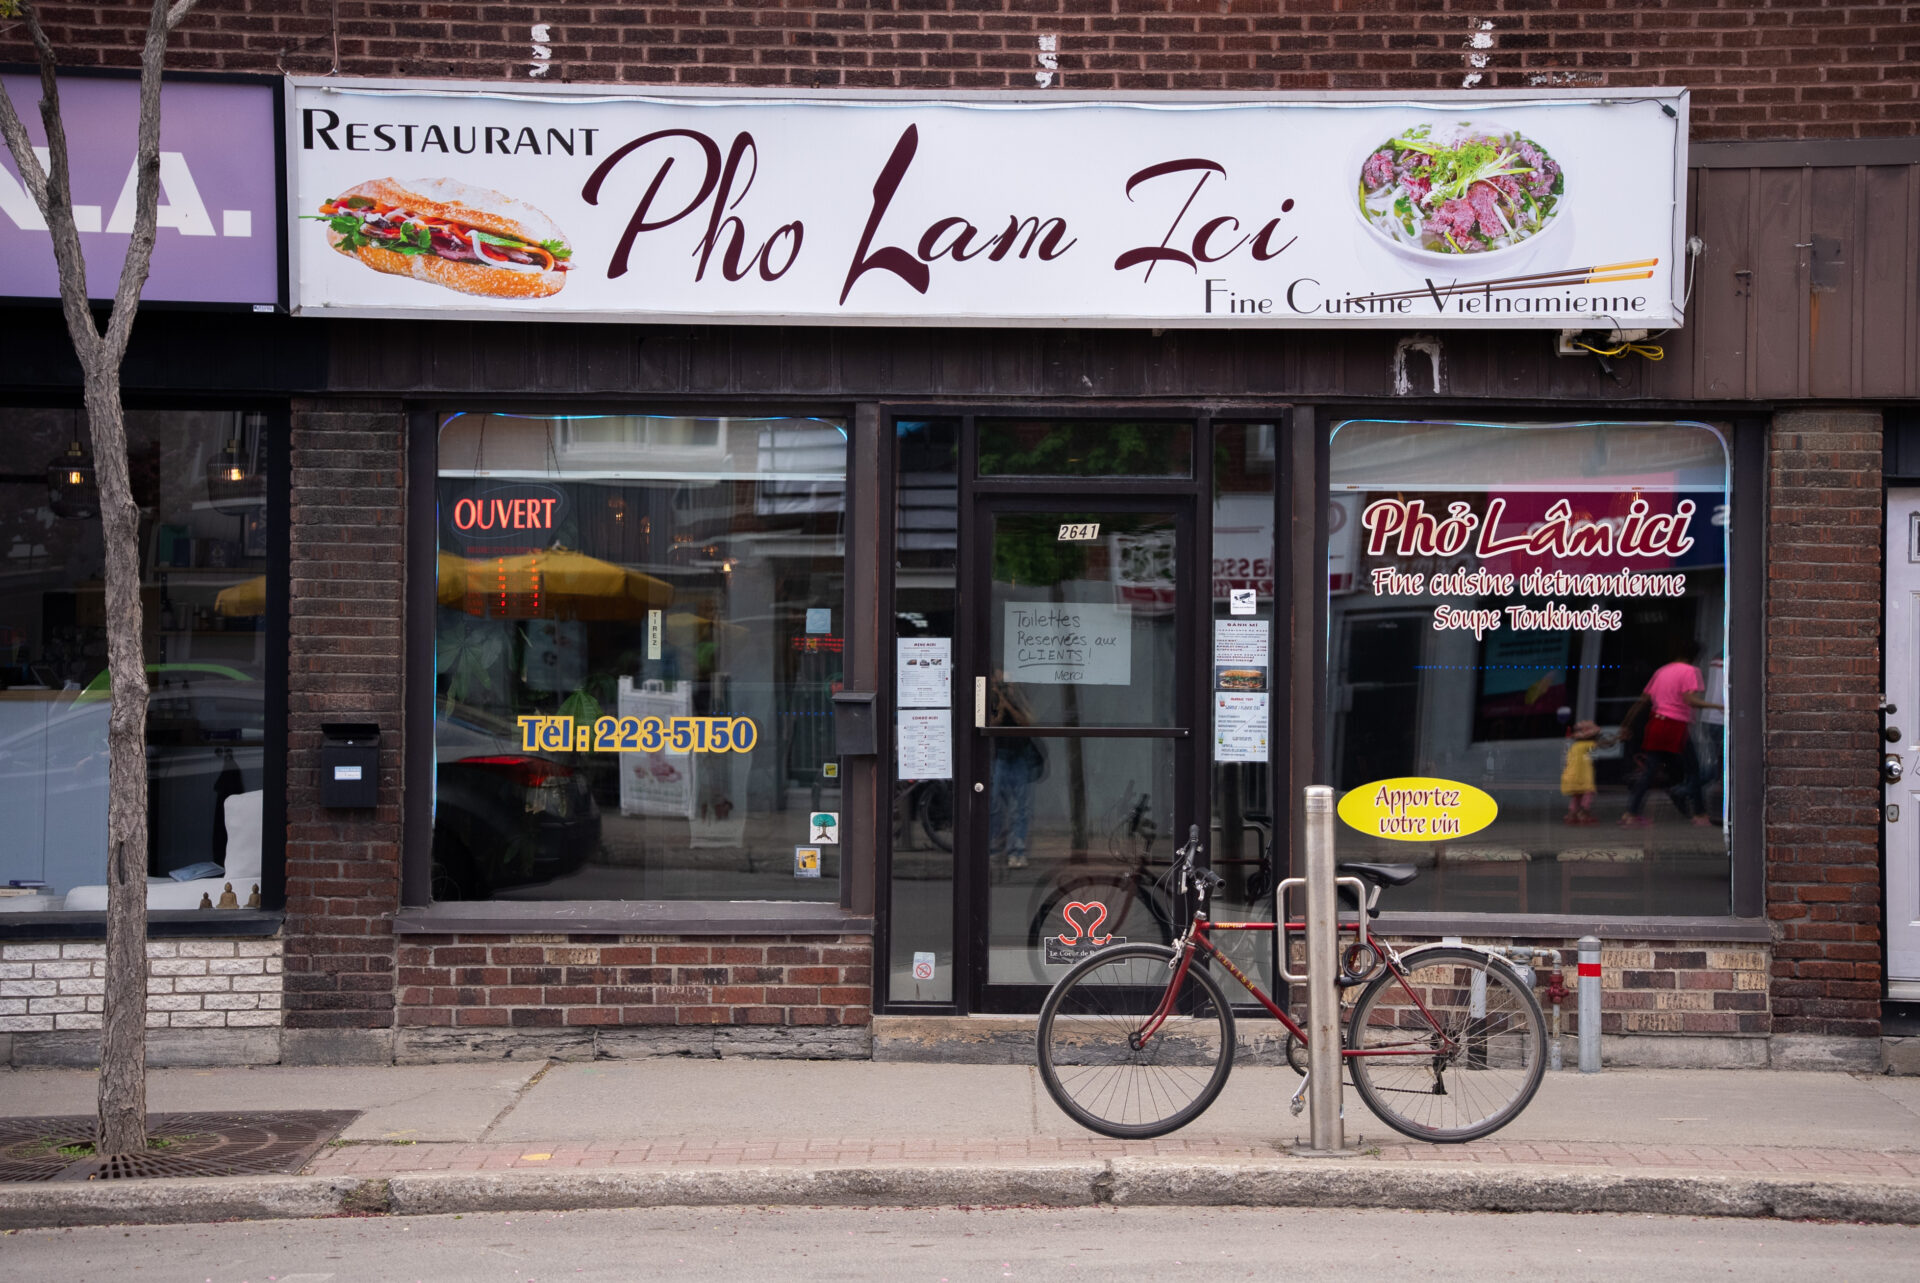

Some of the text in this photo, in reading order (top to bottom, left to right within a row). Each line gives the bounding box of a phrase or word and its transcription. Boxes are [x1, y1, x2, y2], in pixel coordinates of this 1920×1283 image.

[581, 123, 1298, 306] Pho Lam Ici
[1204, 278, 1647, 315] Fine Cuisine Vietnamienne
[453, 498, 556, 531] OUVERT
[1476, 498, 1614, 559] Lâm
[1616, 498, 1697, 558] ici
[1060, 525, 1097, 539] 2641
[1371, 566, 1686, 597] Fine cuisine vietnamienne
[1012, 608, 1081, 628] Toilettes
[1433, 601, 1622, 641] Soupe Tonkinoise
[1095, 636, 1117, 646] aux
[1055, 670, 1084, 681] Merci
[594, 716, 758, 753] 223-5150
[1374, 785, 1461, 813] Apportez
[1380, 812, 1460, 834] votre vin
